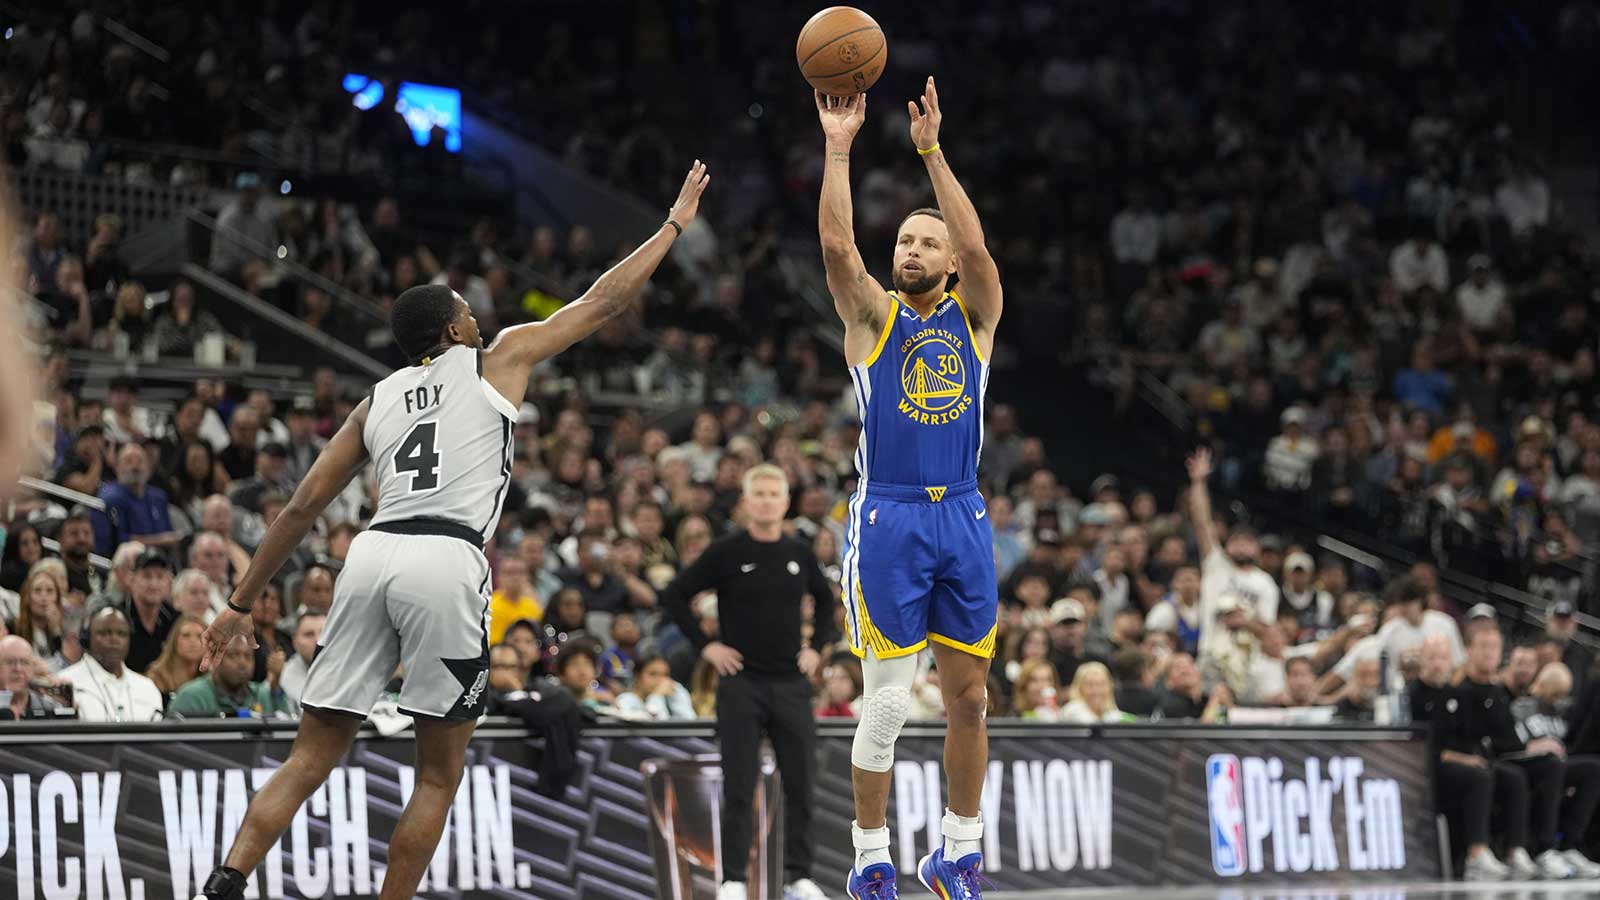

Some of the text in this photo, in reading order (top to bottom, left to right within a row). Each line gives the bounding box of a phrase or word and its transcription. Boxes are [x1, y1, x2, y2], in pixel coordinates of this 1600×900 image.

[901, 328, 964, 353] GOLDEN STATE
[937, 354, 959, 376] 30
[404, 384, 444, 414] FOX
[898, 394, 973, 425] WARRIORS
[391, 419, 442, 494] 4
[0, 770, 145, 900] ICK.
[894, 759, 1113, 875] PLY NOW
[1241, 755, 1406, 874] Pick'Em
